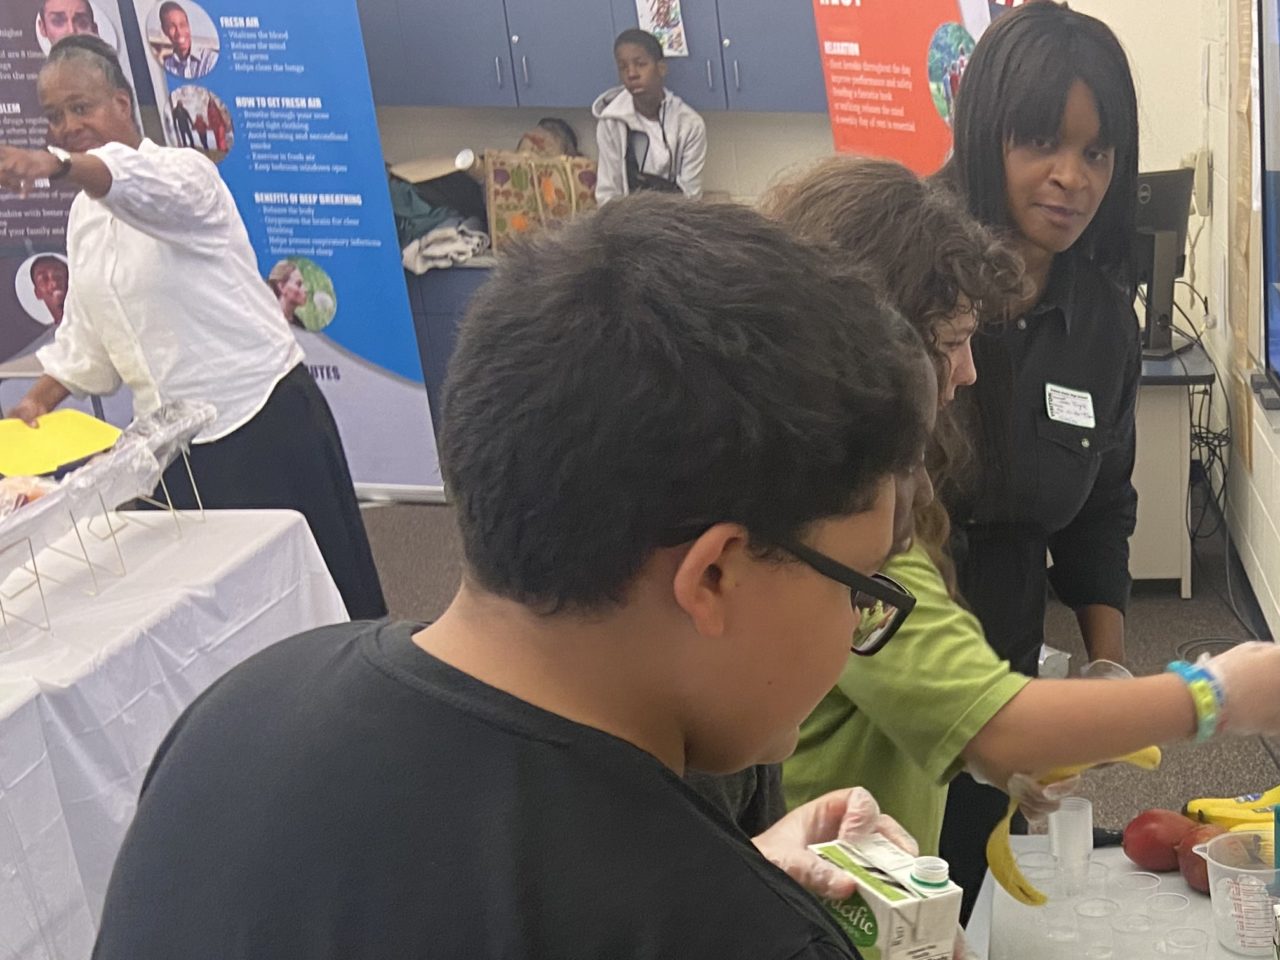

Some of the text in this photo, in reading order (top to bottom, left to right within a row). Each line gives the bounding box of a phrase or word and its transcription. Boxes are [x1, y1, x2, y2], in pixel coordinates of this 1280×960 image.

[220, 16, 260, 28] FRESH AIR
[235, 96, 322, 109] HOW TO GET FRESH AIR
[254, 192, 362, 206] BENEFITS OF DEEP BREATHING
